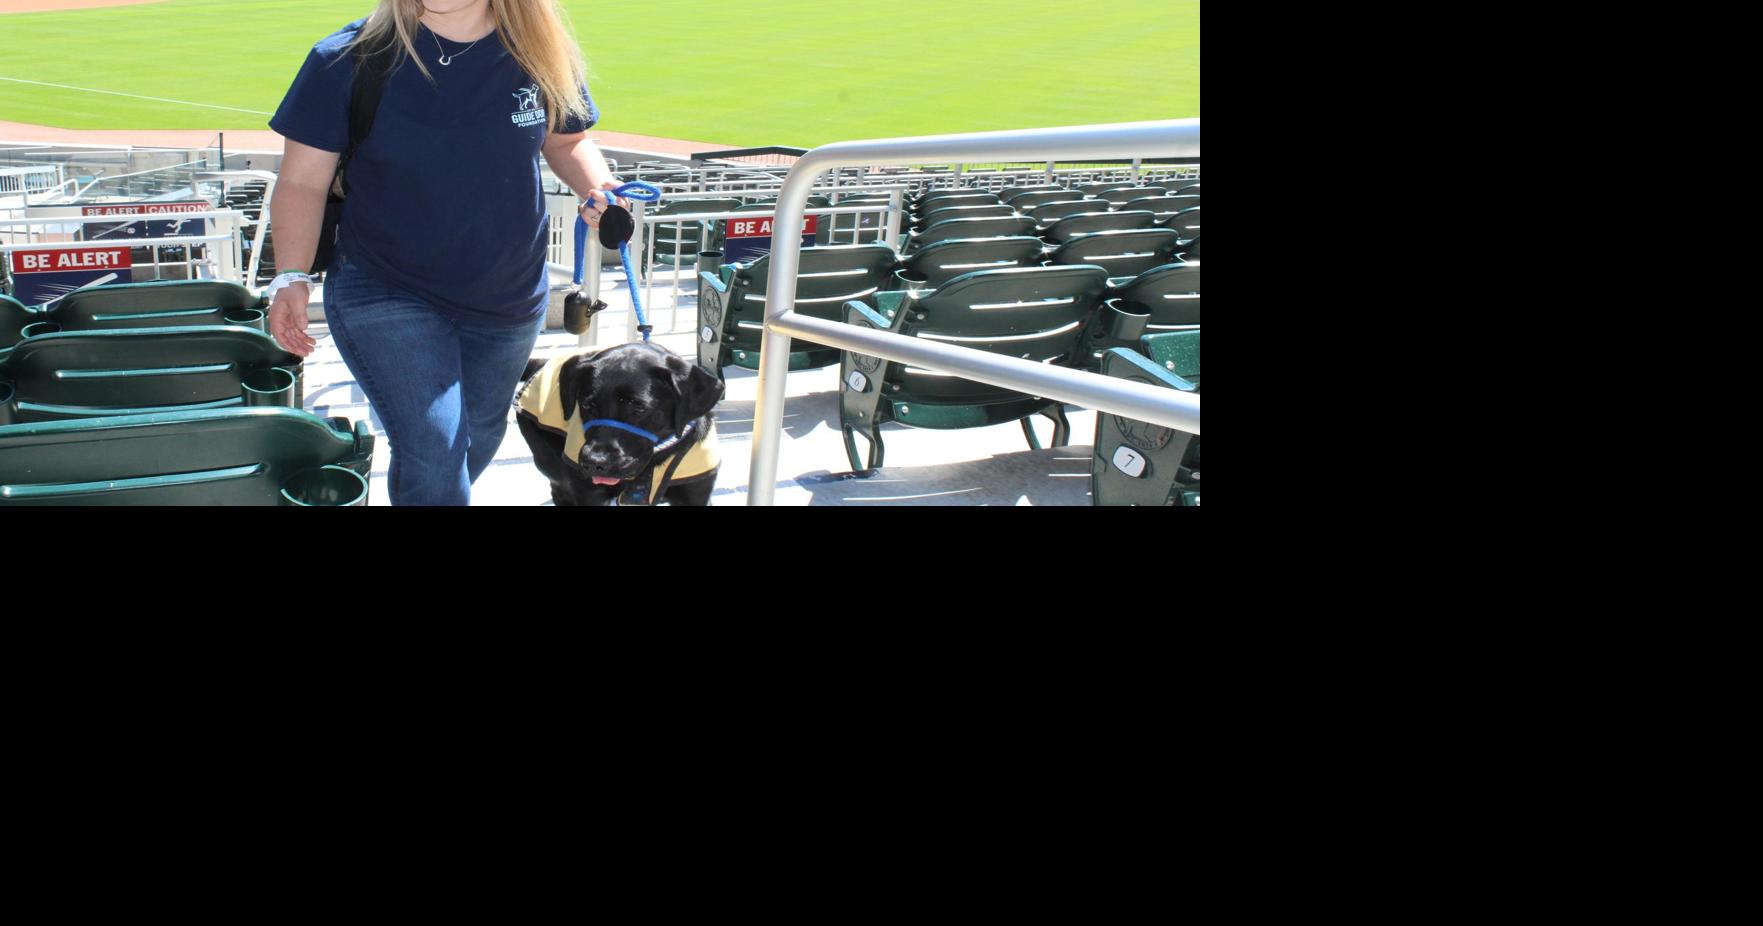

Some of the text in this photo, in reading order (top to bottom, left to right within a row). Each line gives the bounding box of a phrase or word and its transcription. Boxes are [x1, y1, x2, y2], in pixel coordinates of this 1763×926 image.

[511, 108, 545, 124] GUIDE DO
[87, 207, 140, 216] BE ALERT
[148, 204, 206, 214] CAUTION
[734, 221, 756, 234] BE
[22, 251, 121, 269] BE ALERT
[1124, 454, 1135, 468] 7
